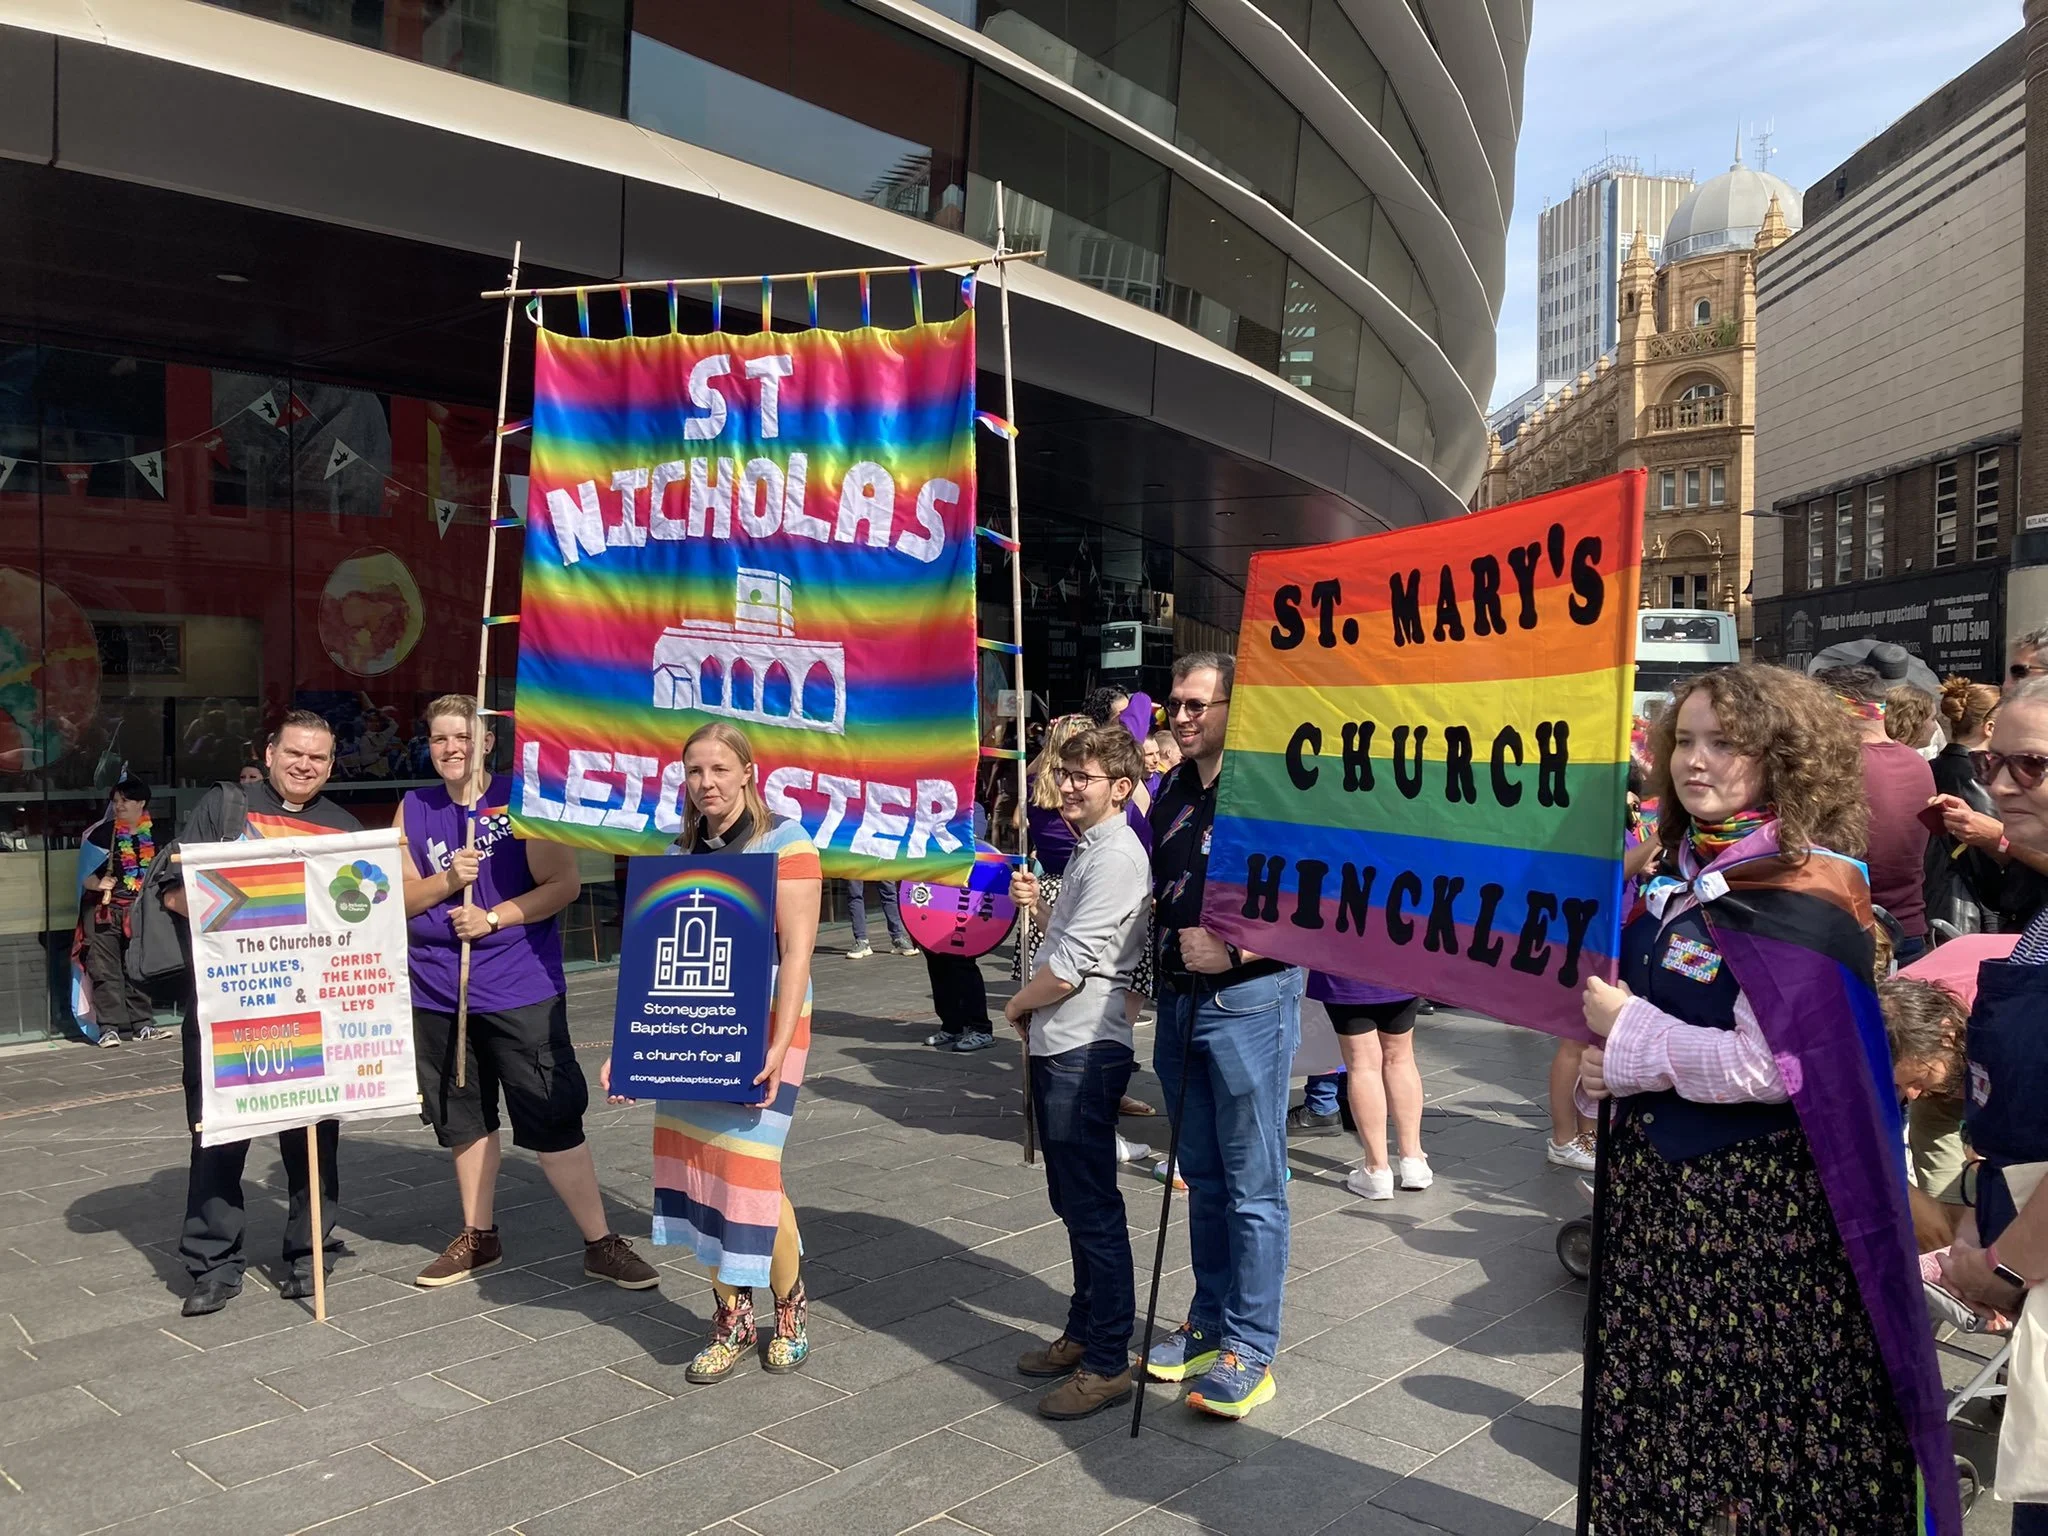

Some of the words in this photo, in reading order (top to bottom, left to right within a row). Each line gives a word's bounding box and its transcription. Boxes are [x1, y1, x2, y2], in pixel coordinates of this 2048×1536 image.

[684, 353, 793, 440] ST
[546, 452, 960, 566] NICHOLAS
[1270, 578, 1360, 650] ST.
[1389, 523, 1604, 647] MARY'S
[1932, 624, 1951, 644] 0870
[1953, 622, 1967, 642] 600
[1969, 620, 1989, 641] 5040
[1285, 720, 1571, 808] CHURCH
[521, 741, 961, 860] LEICSTER
[1241, 853, 1599, 988] HINCKLEY
[237, 937, 264, 953] The
[269, 933, 332, 951] Churches
[338, 931, 352, 946] of
[1671, 938, 1717, 961] Inclusion
[331, 953, 382, 967] CHRIST
[1667, 948, 1683, 959] not
[207, 963, 248, 979] SAINT
[252, 959, 304, 974] LUKE'S,
[323, 970, 349, 983] THE
[353, 968, 392, 981] KING,
[1666, 958, 1711, 981] exclusion
[221, 976, 293, 993] STOCKING
[319, 982, 396, 999] BEAUMONT
[240, 993, 276, 1007] FARM
[295, 988, 307, 1003] &
[342, 999, 375, 1012] LEYS
[643, 1003, 736, 1018] Stoneygate
[232, 1022, 300, 1042] WELCOME
[339, 1023, 367, 1039] YOU
[371, 1023, 392, 1037] are
[631, 1022, 688, 1036] Baptist
[691, 1023, 747, 1035] Church
[242, 1041, 295, 1077] YOU!
[326, 1039, 405, 1062] FEARFULLY
[633, 1051, 644, 1060] a
[646, 1049, 696, 1061] church
[699, 1050, 722, 1062] for
[725, 1051, 741, 1063] all
[358, 1060, 383, 1077] and
[630, 1074, 741, 1086] stoneygatebaptist.org.uk
[235, 1086, 340, 1114] WONDERFULLY
[345, 1081, 386, 1100] MADE
